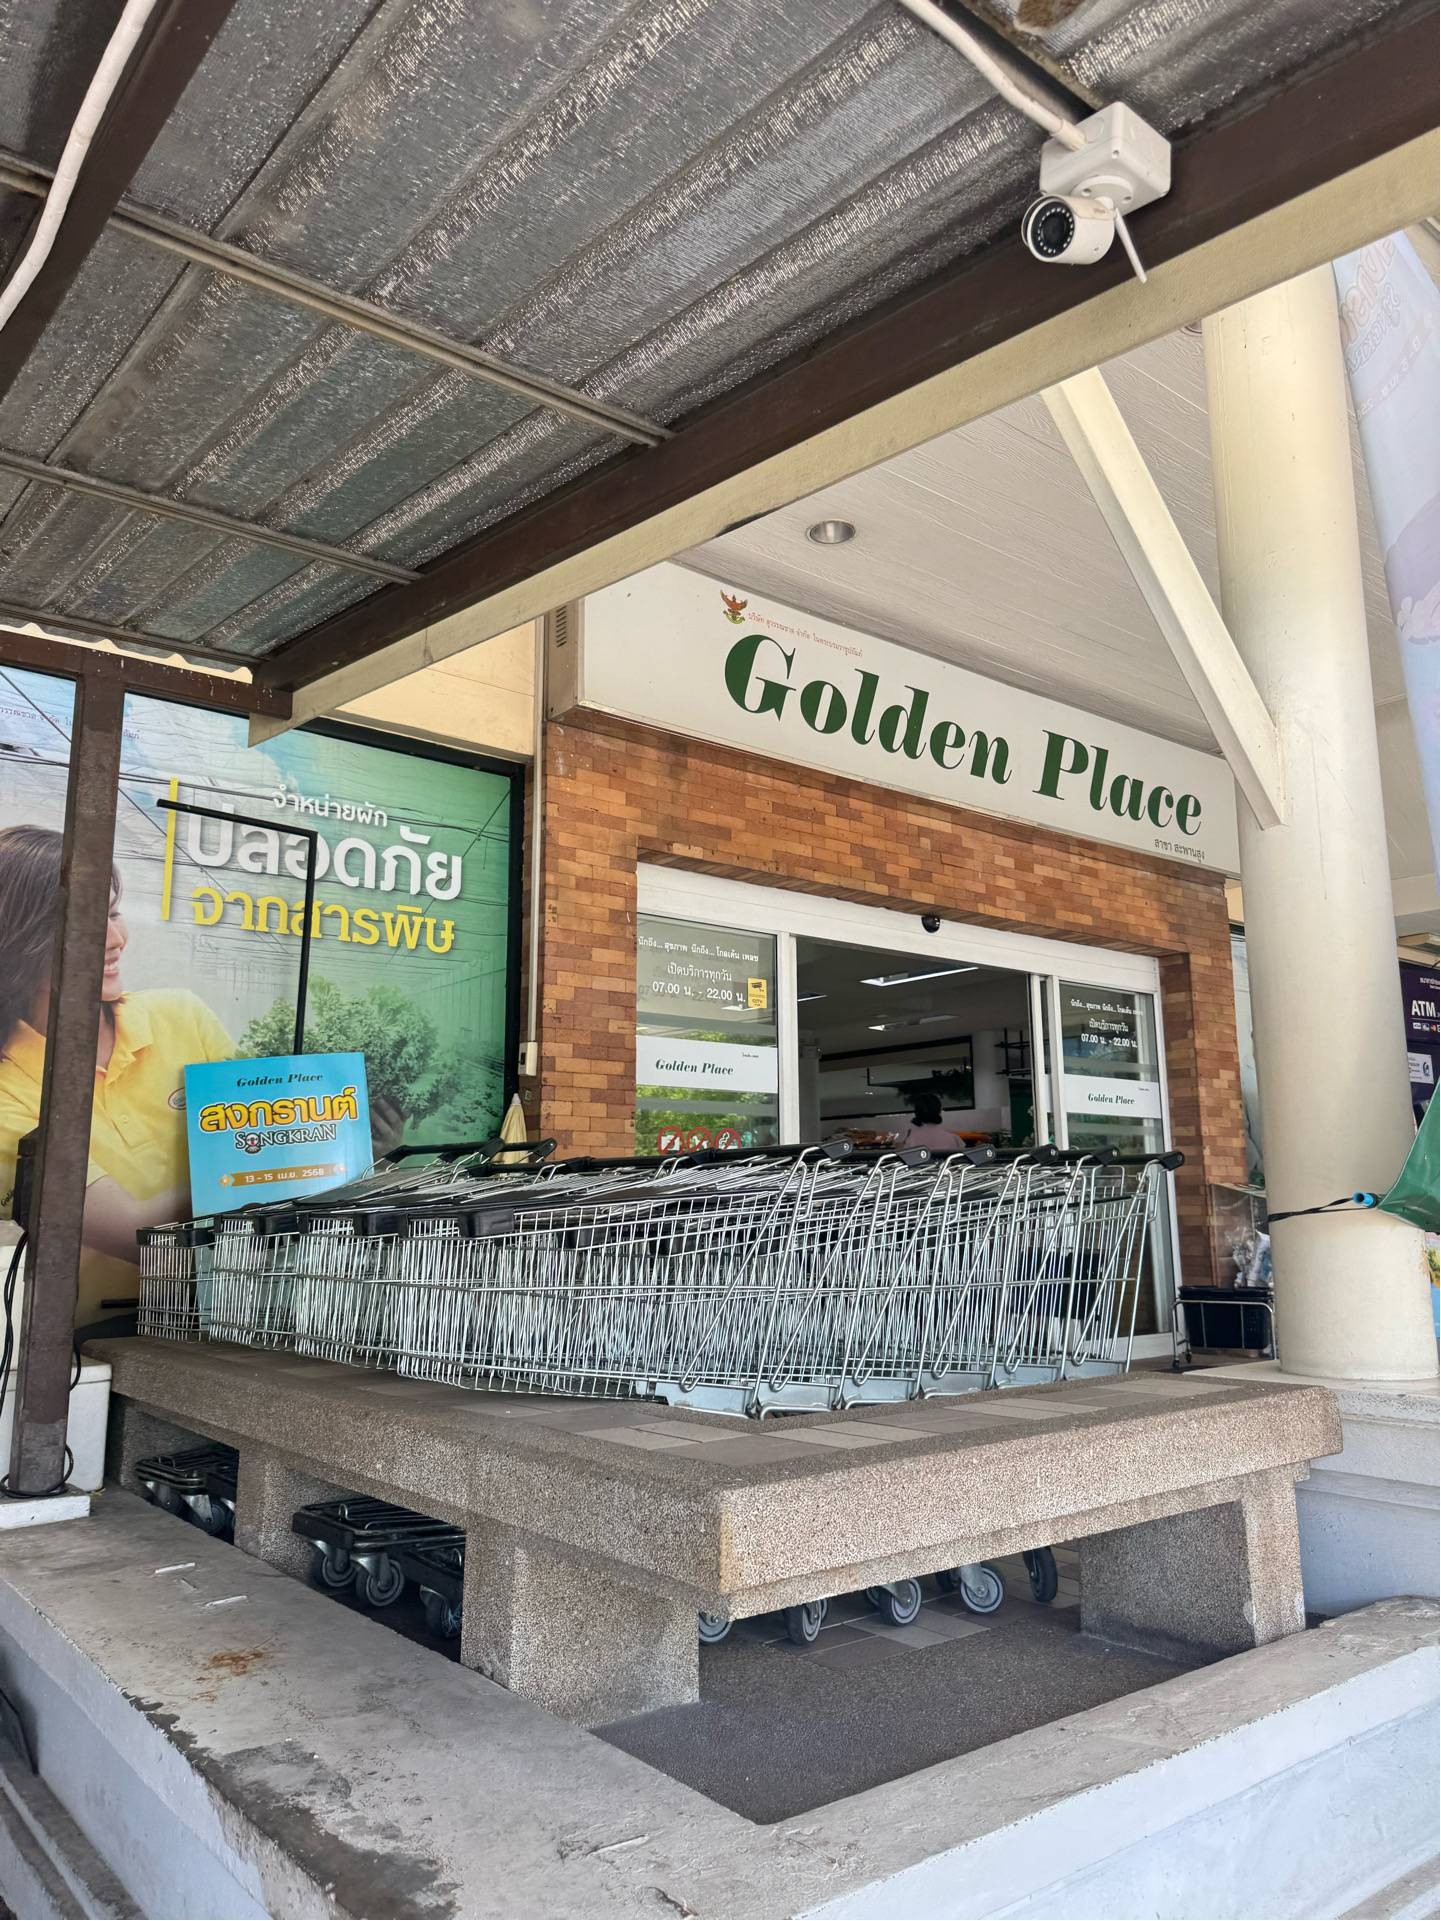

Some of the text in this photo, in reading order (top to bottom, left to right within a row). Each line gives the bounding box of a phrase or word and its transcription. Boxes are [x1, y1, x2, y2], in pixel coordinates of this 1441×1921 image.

[724, 634, 1203, 836] Golden Place
[272, 784, 388, 828] จำหน่ายผัก
[187, 802, 463, 901] ปลอดภัย
[1154, 838, 1205, 864] สาขา สะพานสูง
[191, 887, 456, 954] จากสารพิษ
[664, 941, 688, 953] สุขภาพ
[667, 961, 732, 984] เปิดบริการทุกวัน
[652, 981, 680, 995] 07.00
[683, 985, 694, 997] น.
[706, 987, 733, 1001] 22.00
[736, 991, 746, 1003] น.
[1411, 1000, 1436, 1017] ATM
[1081, 1033, 1098, 1044] 07.00
[1113, 1037, 1130, 1047] 22.00
[655, 1058, 734, 1075] Golden Place
[236, 1072, 323, 1087] Golden Place
[200, 1086, 358, 1133] สงกรานต์
[1087, 1093, 1135, 1105] Golden Place
[235, 1123, 337, 1150] SONGKRAN
[245, 1174, 255, 1183] 13
[264, 1173, 273, 1181] 15
[277, 1172, 299, 1181] เม.ย.
[301, 1167, 325, 1177] 2568
